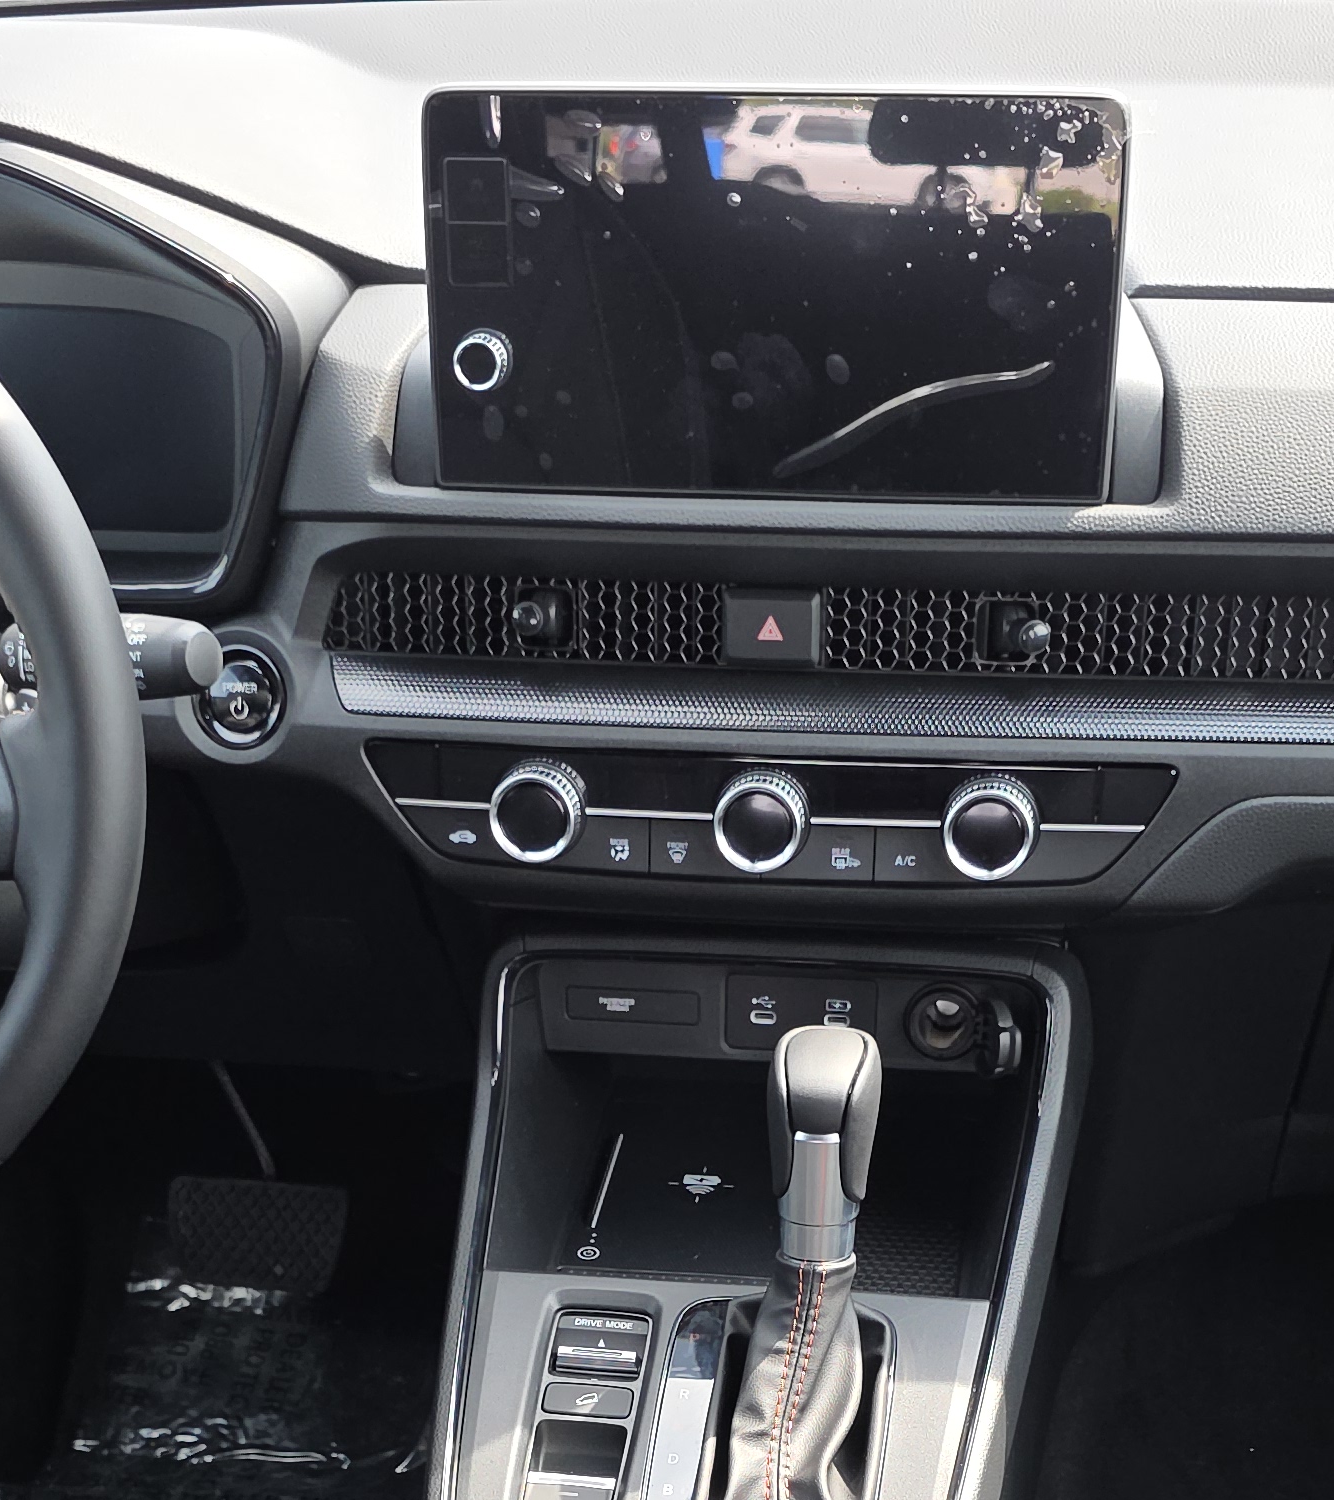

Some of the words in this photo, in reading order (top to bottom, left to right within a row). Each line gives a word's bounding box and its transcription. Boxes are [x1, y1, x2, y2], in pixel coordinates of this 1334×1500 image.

[221, 681, 258, 694] POWER
[894, 854, 916, 866] A/C
[574, 1317, 604, 1328] DRIVE
[605, 1320, 634, 1330] MODE
[679, 1388, 690, 1400] R
[668, 1453, 679, 1465] D
[662, 1484, 674, 1496] B
